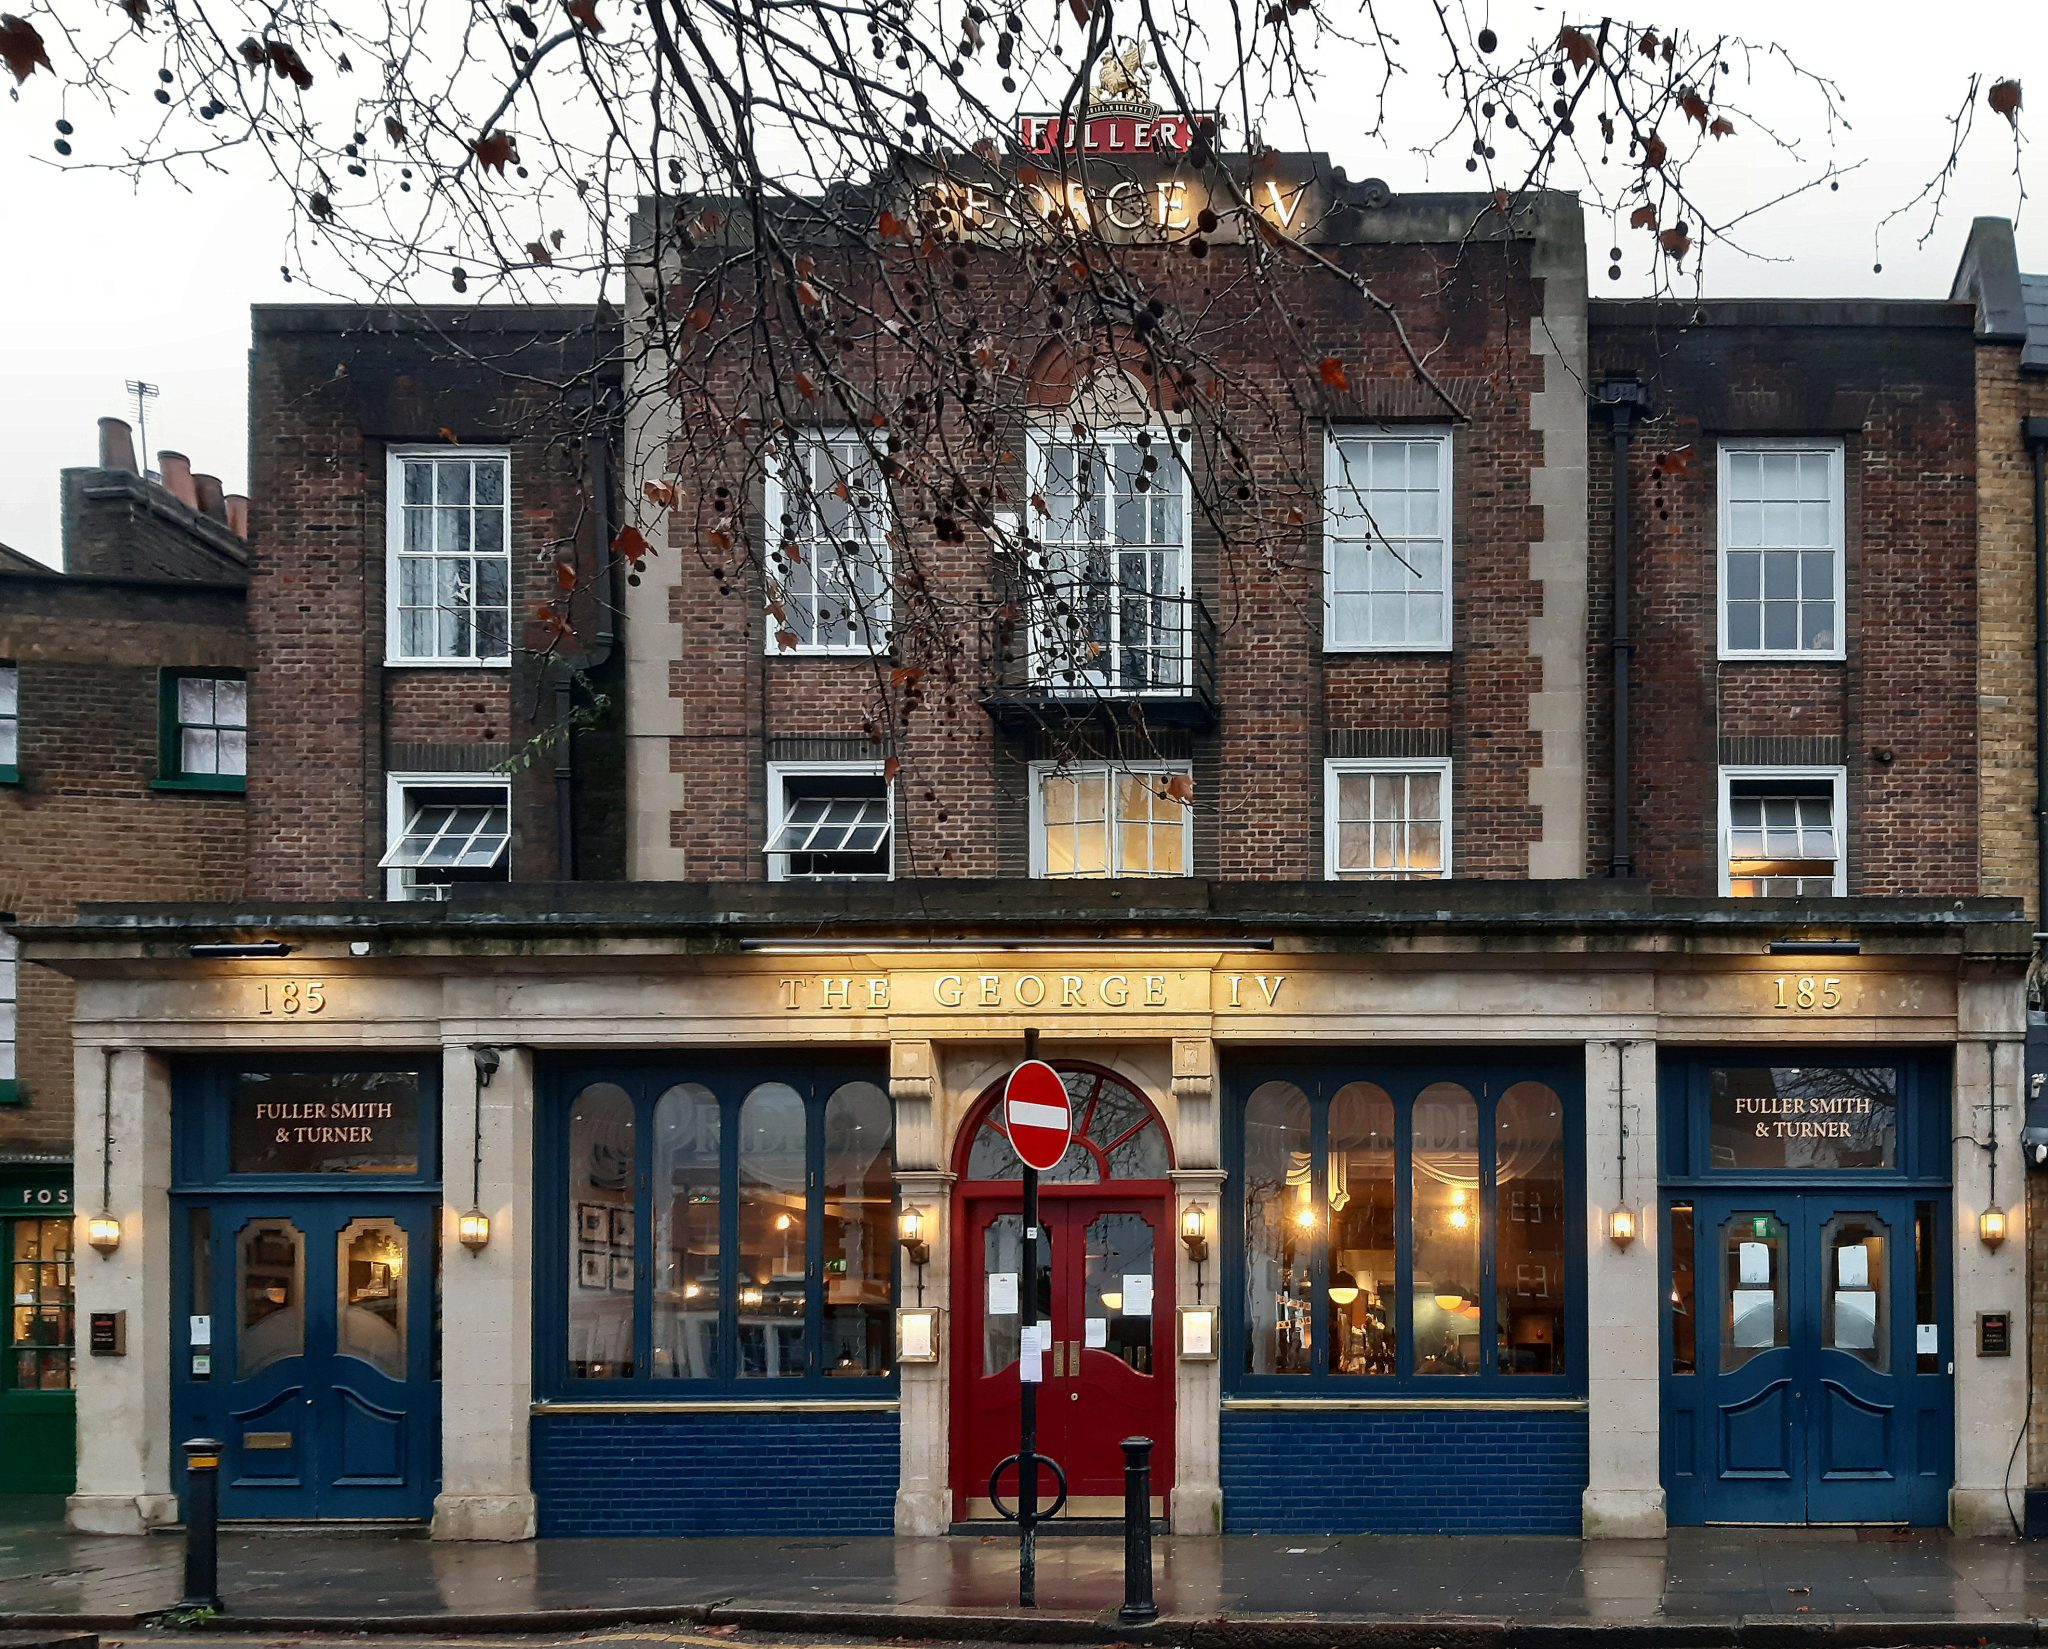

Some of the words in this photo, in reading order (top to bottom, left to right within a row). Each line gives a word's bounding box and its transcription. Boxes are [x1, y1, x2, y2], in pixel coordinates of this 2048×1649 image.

[257, 982, 326, 1014] 185
[779, 978, 891, 1009] THE
[933, 975, 1168, 1008] GEORGE
[1228, 976, 1286, 1007] IV
[1773, 977, 1842, 1009] 185
[256, 1103, 327, 1119] FULLER
[330, 1103, 393, 1119] SMITH
[1735, 1098, 1807, 1114] FULLER
[1809, 1098, 1871, 1114] SMITH
[275, 1127, 290, 1142] &
[294, 1126, 374, 1142] TURNER
[1755, 1121, 1769, 1137] &
[1773, 1121, 1851, 1137] TURNER
[23, 1189, 68, 1203] FOS
